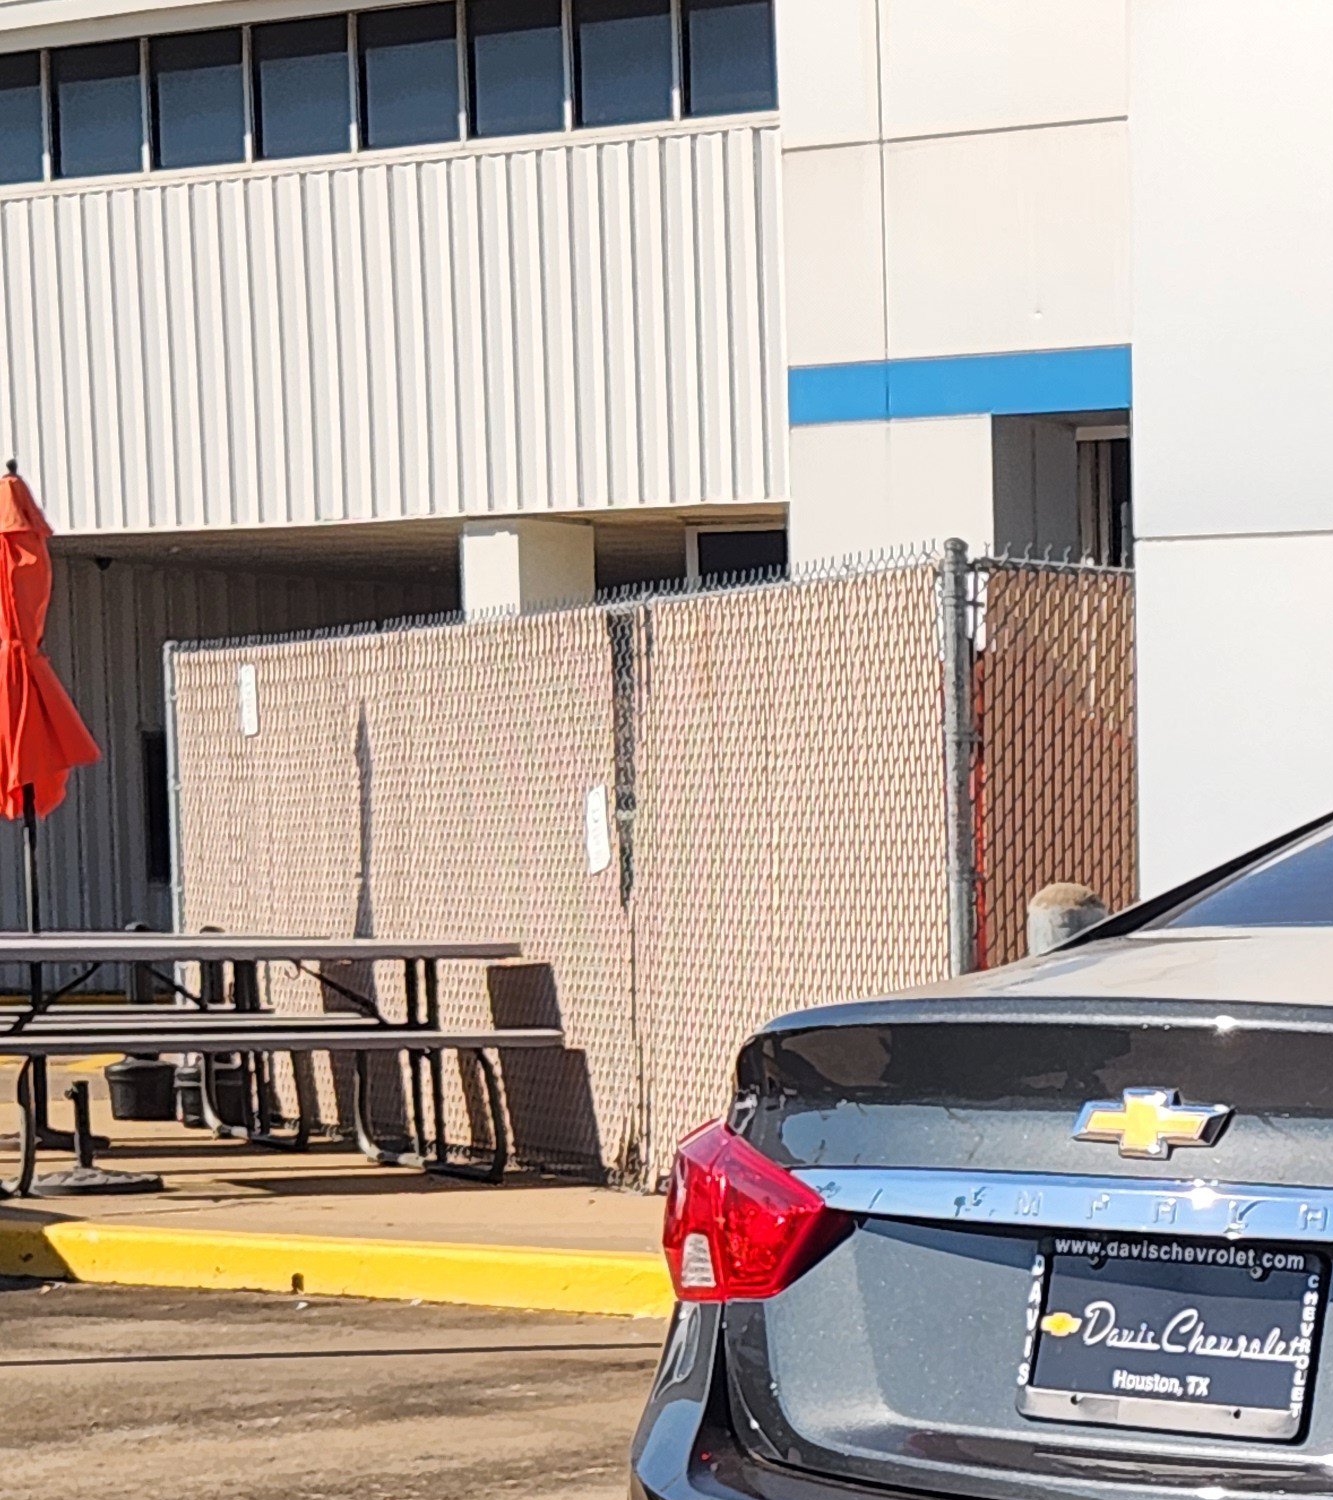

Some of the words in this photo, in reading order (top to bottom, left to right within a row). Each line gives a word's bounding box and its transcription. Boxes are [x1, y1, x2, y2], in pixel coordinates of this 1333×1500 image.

[1054, 1238, 1305, 1270] www.davischevrolet.com
[1016, 1254, 1045, 1386] DAVIS
[1083, 1300, 1161, 1350] Davis
[1161, 1308, 1302, 1361] Chevrolet
[1112, 1369, 1183, 1396] Houston,
[1186, 1375, 1211, 1396] TX
